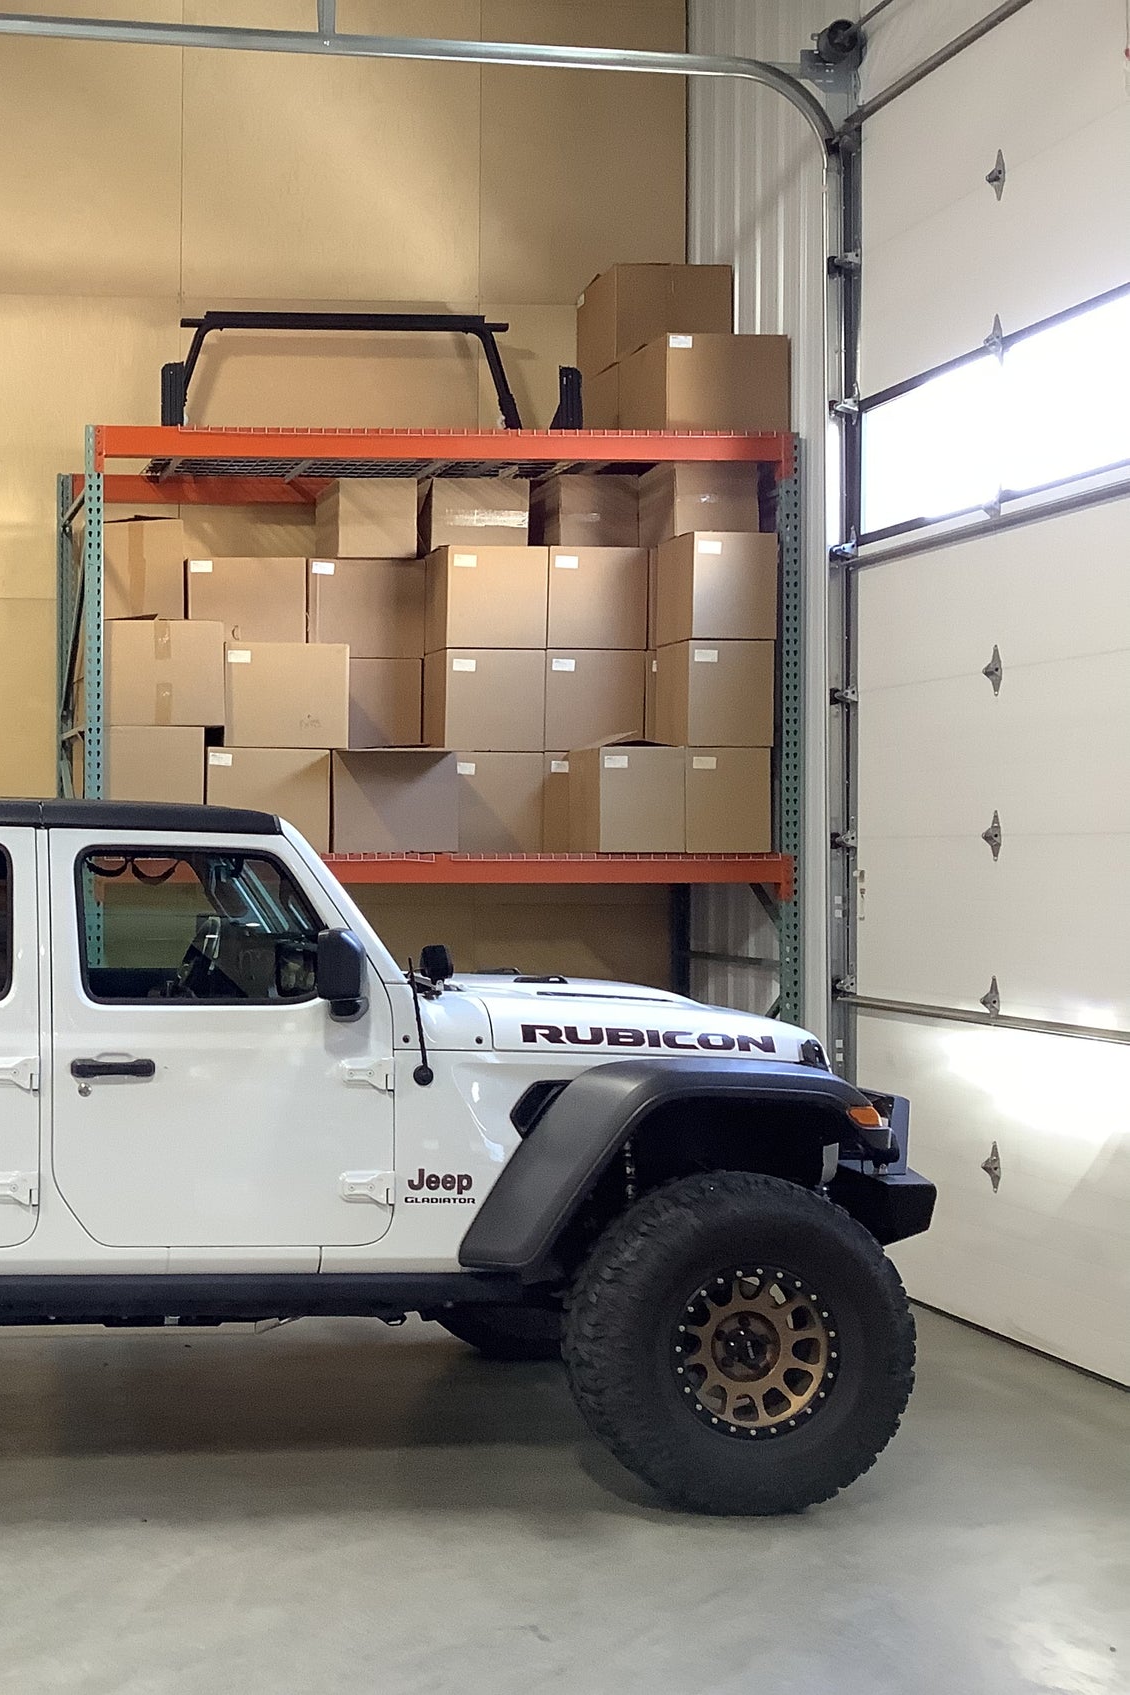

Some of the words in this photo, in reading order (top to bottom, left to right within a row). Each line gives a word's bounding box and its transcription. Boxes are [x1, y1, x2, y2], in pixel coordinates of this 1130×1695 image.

[521, 1023, 776, 1054] RUBICON
[407, 1168, 473, 1195] Jeep
[404, 1196, 476, 1204] GLADIATOR
